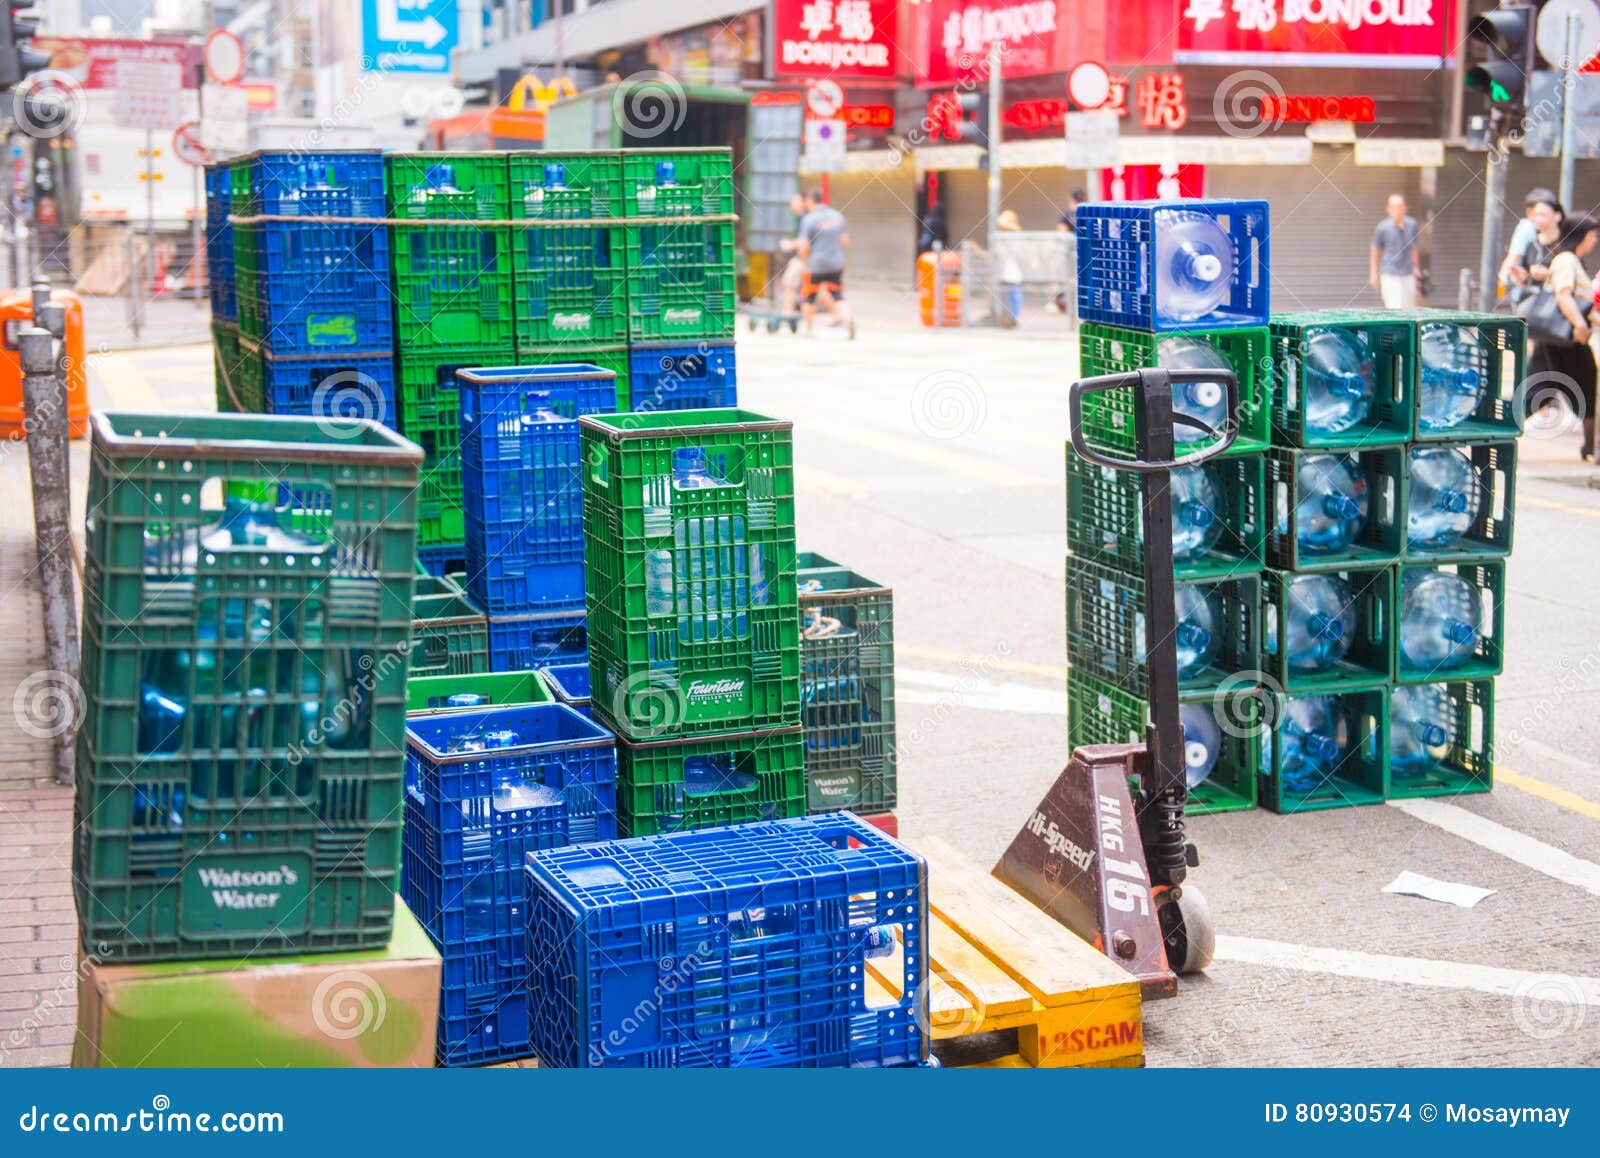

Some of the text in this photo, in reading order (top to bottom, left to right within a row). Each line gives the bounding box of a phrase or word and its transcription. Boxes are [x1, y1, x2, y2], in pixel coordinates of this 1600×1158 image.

[1282, 0, 1434, 31] BONJOUR
[782, 40, 890, 69] BONJOUR
[1260, 95, 1377, 123] BONJOUR
[686, 678, 745, 699] Fountain
[820, 786, 849, 796] Water
[1026, 808, 1097, 873] Hi-Speed
[1099, 794, 1150, 917] HKG 16
[198, 864, 299, 888] Watson's
[211, 889, 281, 910] Water
